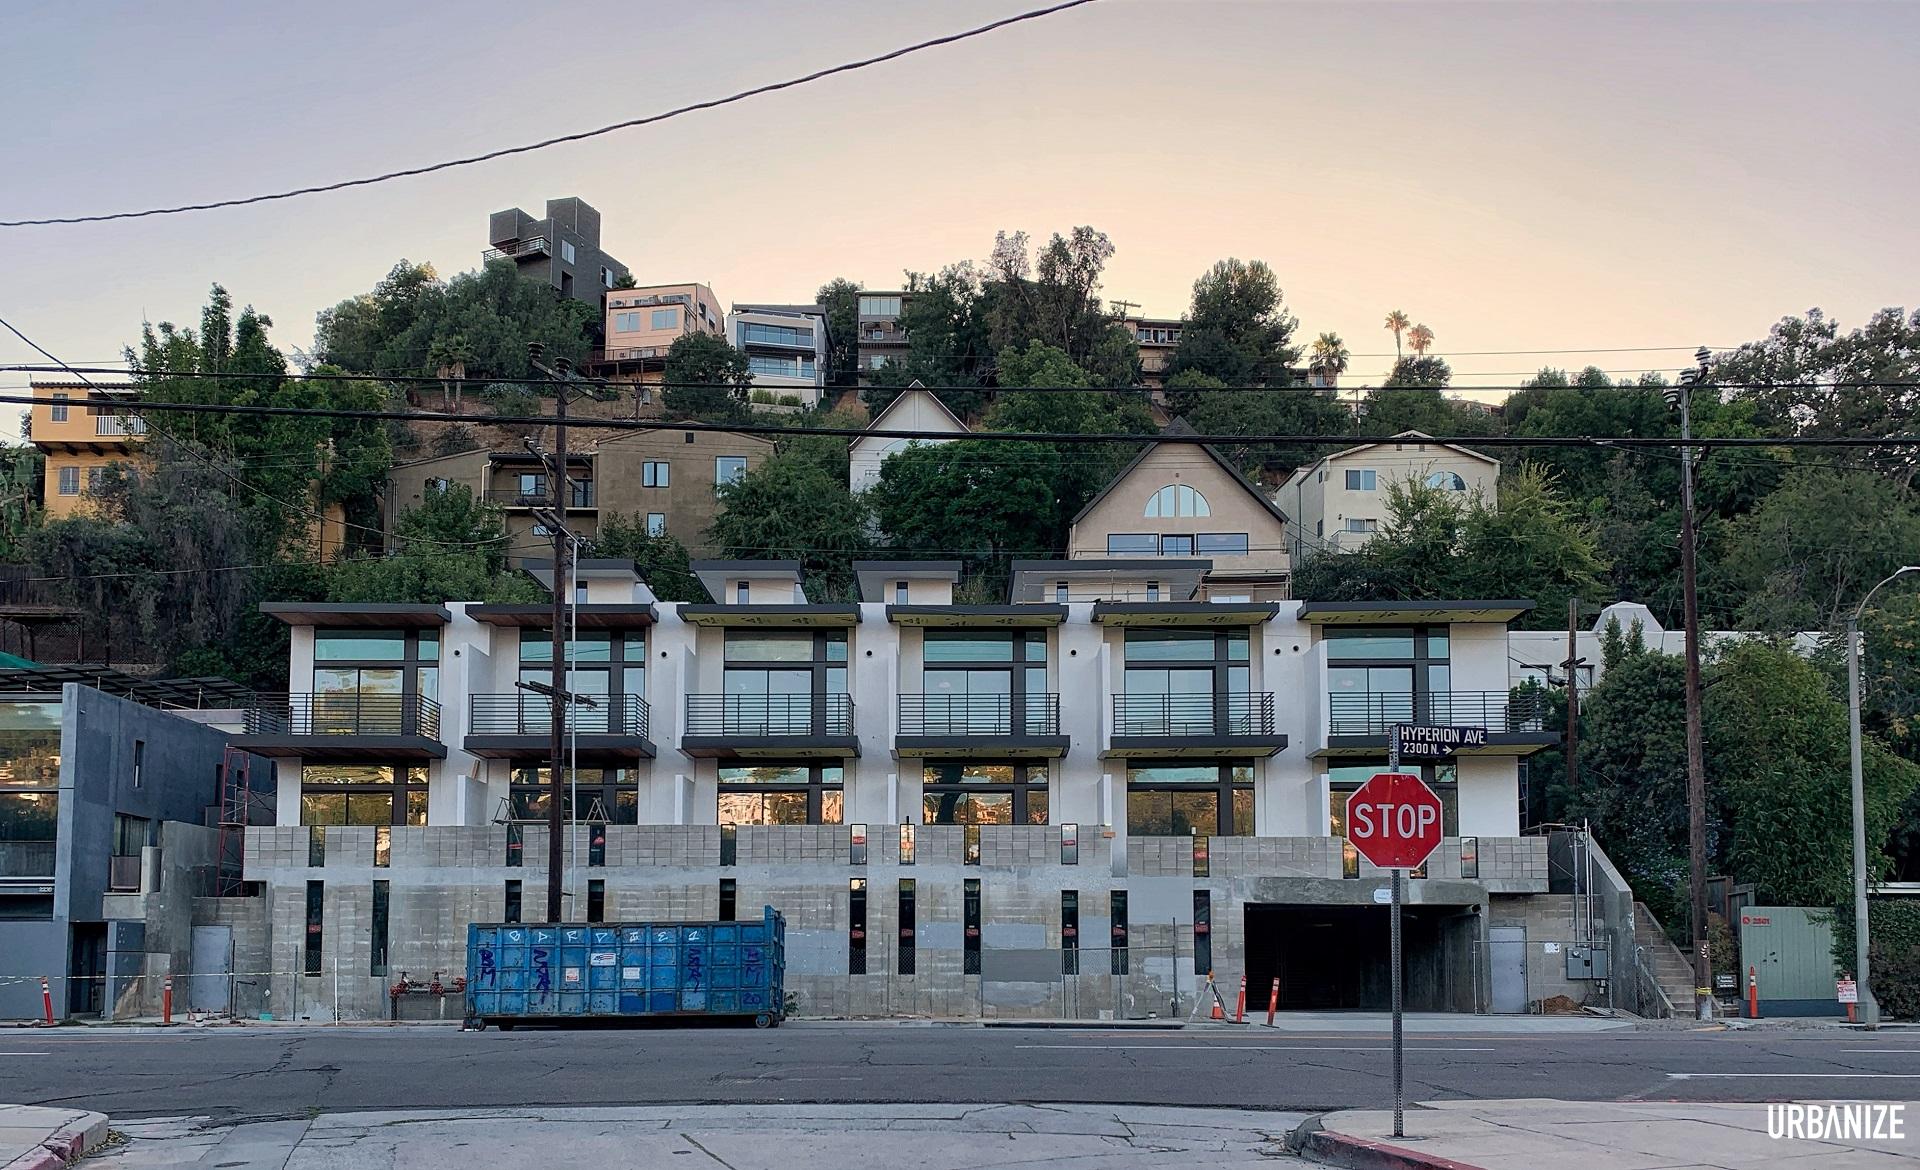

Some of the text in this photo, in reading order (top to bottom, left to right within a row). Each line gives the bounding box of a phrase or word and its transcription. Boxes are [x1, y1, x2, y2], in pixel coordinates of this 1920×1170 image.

[1400, 726, 1460, 743] HYPERION
[1403, 742, 1429, 754] 2300
[1354, 803, 1436, 839] STOP
